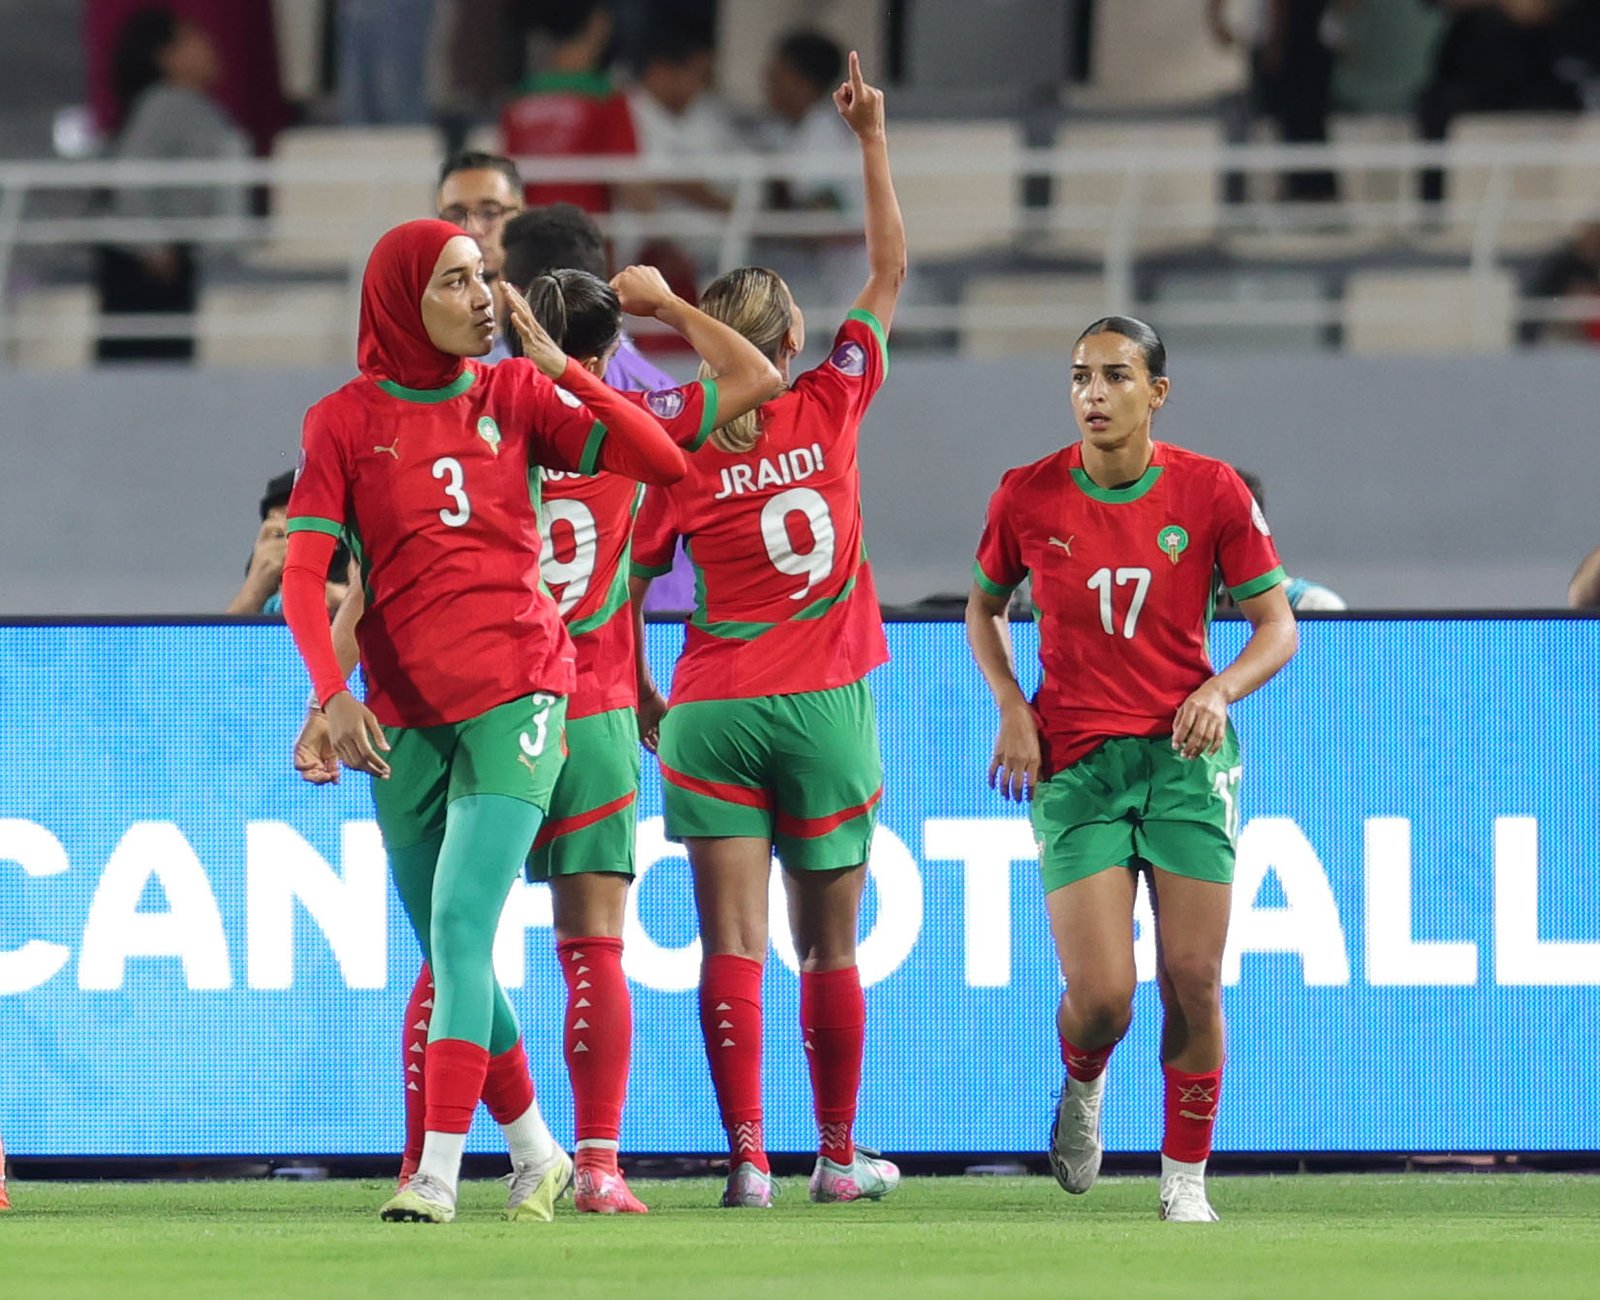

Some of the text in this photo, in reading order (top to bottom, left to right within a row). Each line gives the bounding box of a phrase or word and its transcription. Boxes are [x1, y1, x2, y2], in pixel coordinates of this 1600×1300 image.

[432, 457, 470, 527] 3
[760, 487, 835, 600] 9
[1087, 567, 1152, 639] 17
[519, 692, 556, 757] 3
[492, 816, 1600, 990] OTALL
